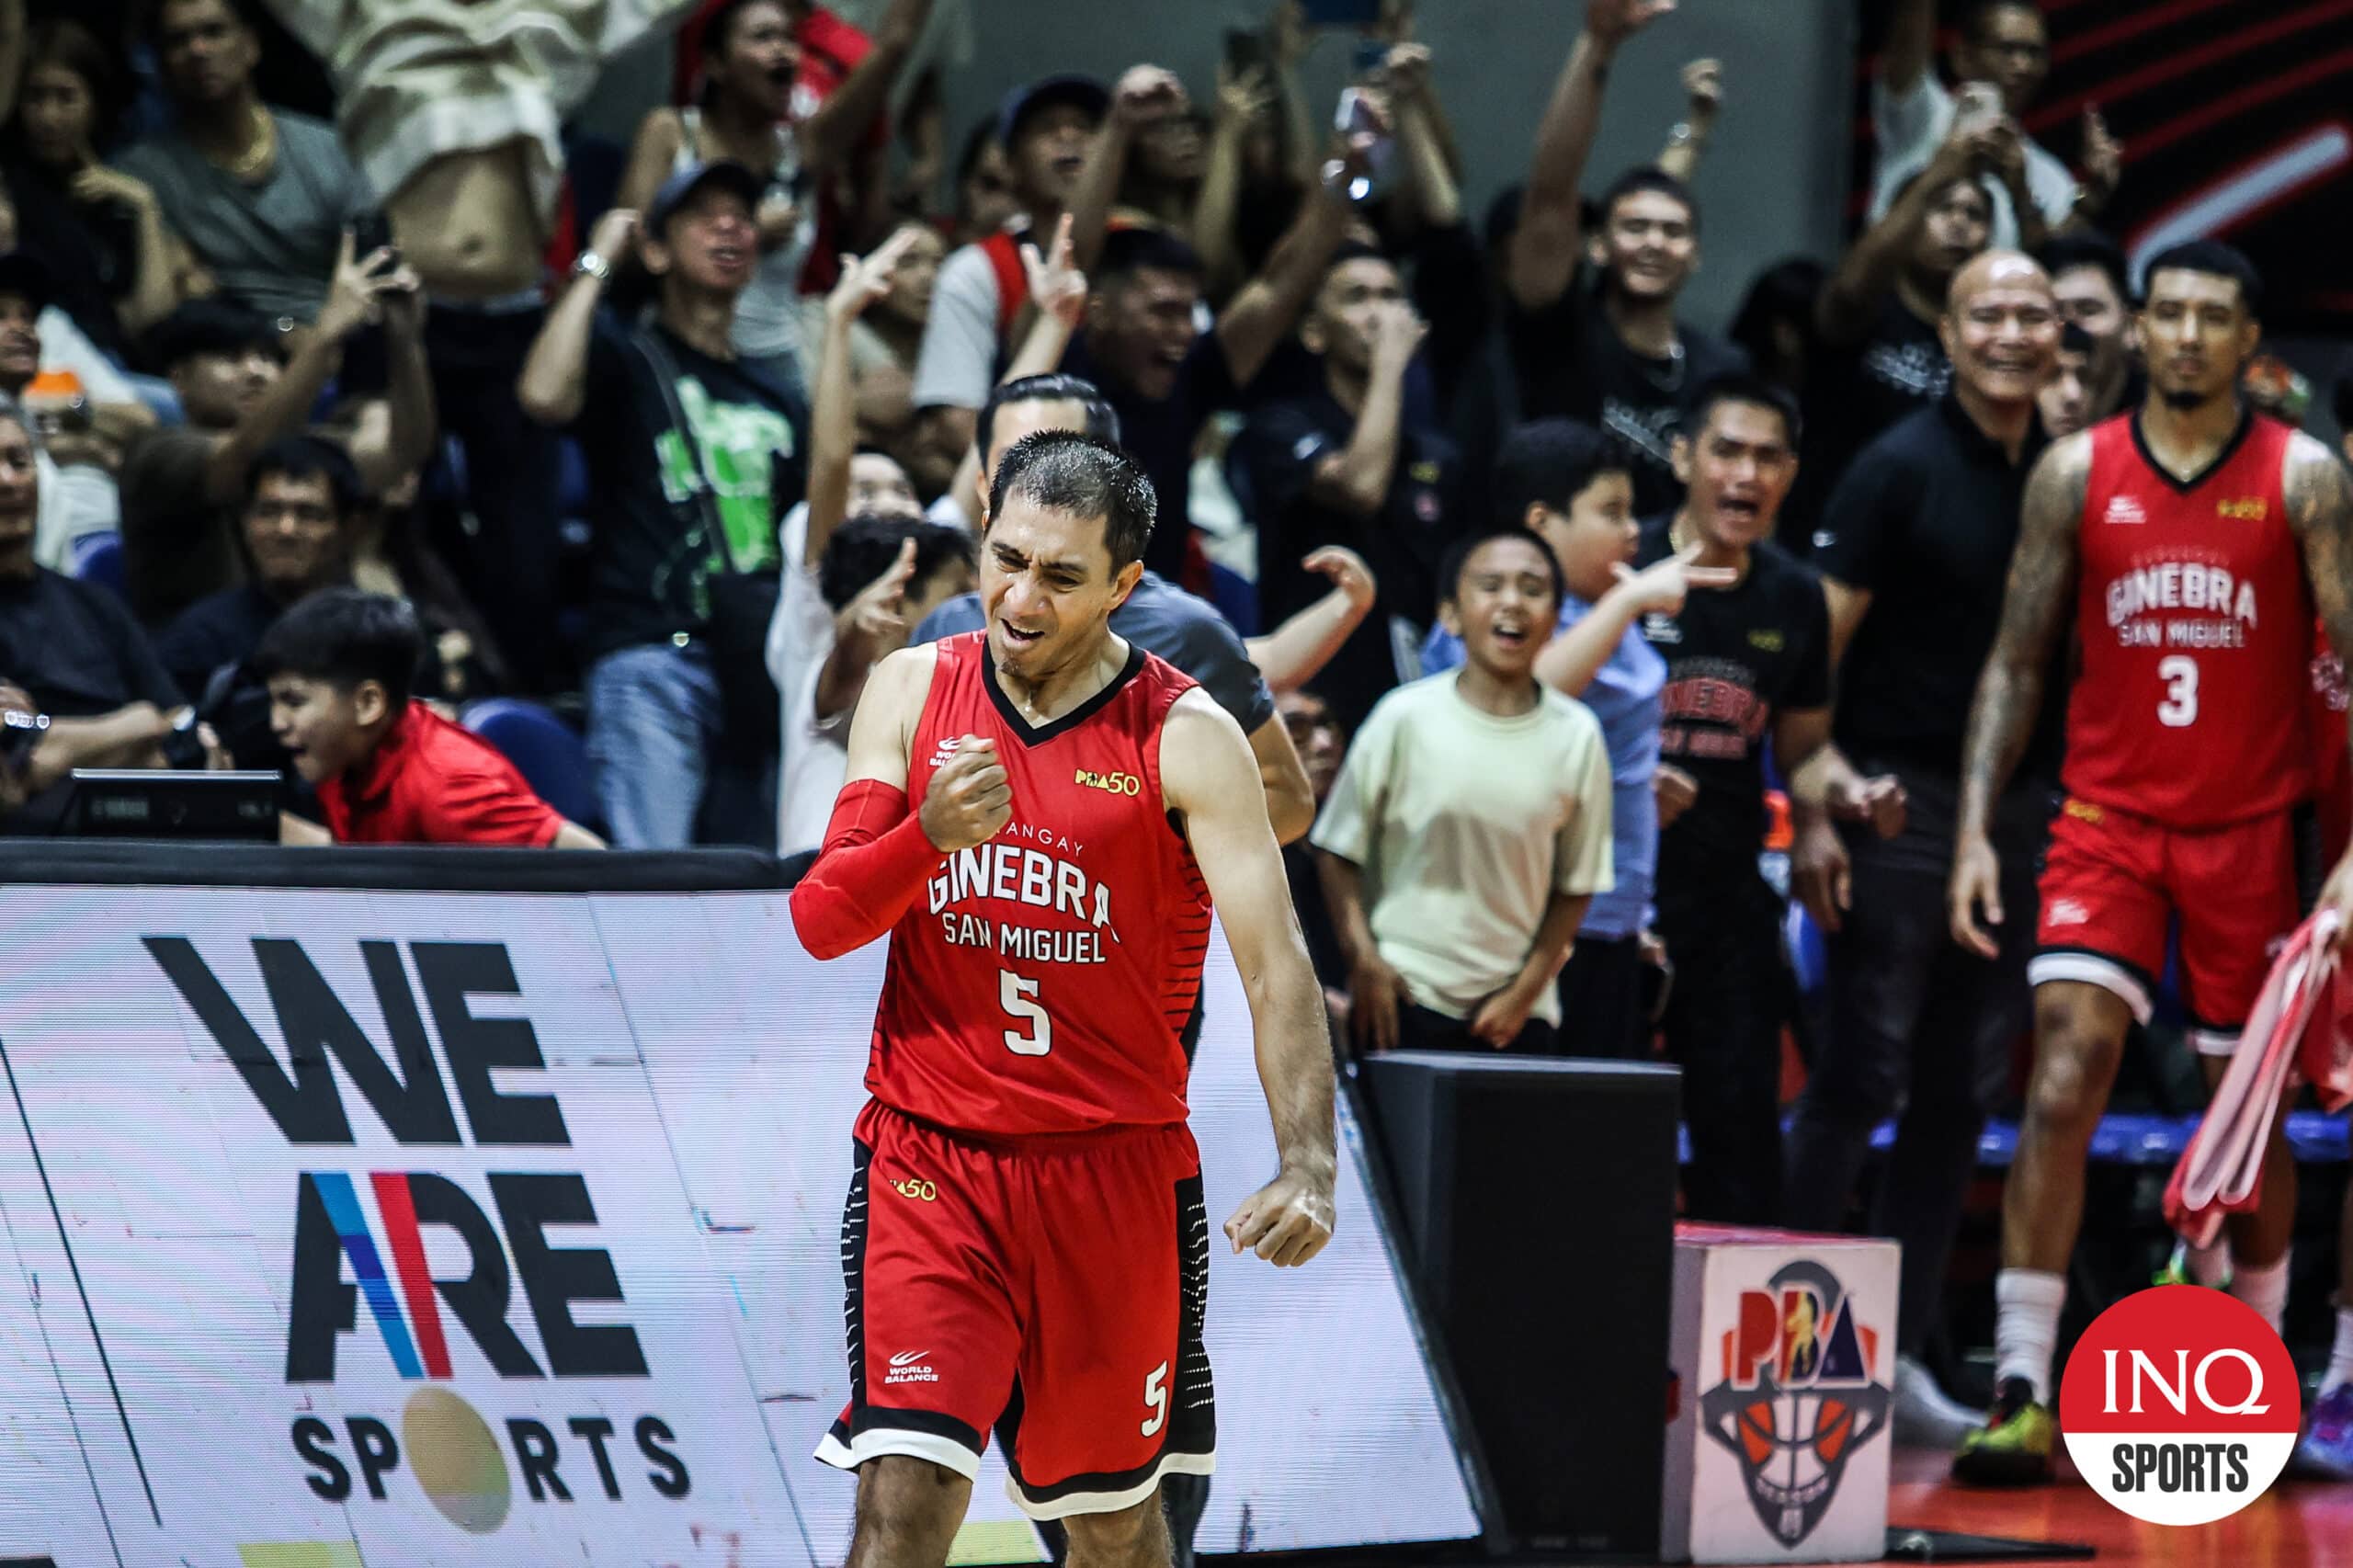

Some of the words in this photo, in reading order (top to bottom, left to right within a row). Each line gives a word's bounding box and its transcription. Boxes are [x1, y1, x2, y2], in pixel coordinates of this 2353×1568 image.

[2106, 562, 2257, 629] GINEBRA
[2119, 618, 2161, 647] SAN
[2157, 654, 2199, 726] 3
[1005, 822, 1084, 858] ANGAY
[927, 843, 1120, 944] GINEBRA
[941, 912, 993, 949] SAN
[1000, 923, 1107, 963] MIGUEL
[140, 936, 574, 1147] WE
[999, 970, 1052, 1057] 5
[285, 1172, 651, 1384] ARE
[889, 1366, 933, 1376] WORLD
[1733, 1289, 1871, 1390] PBA
[884, 1374, 939, 1384] BALANCE
[1140, 1358, 1168, 1438] 5
